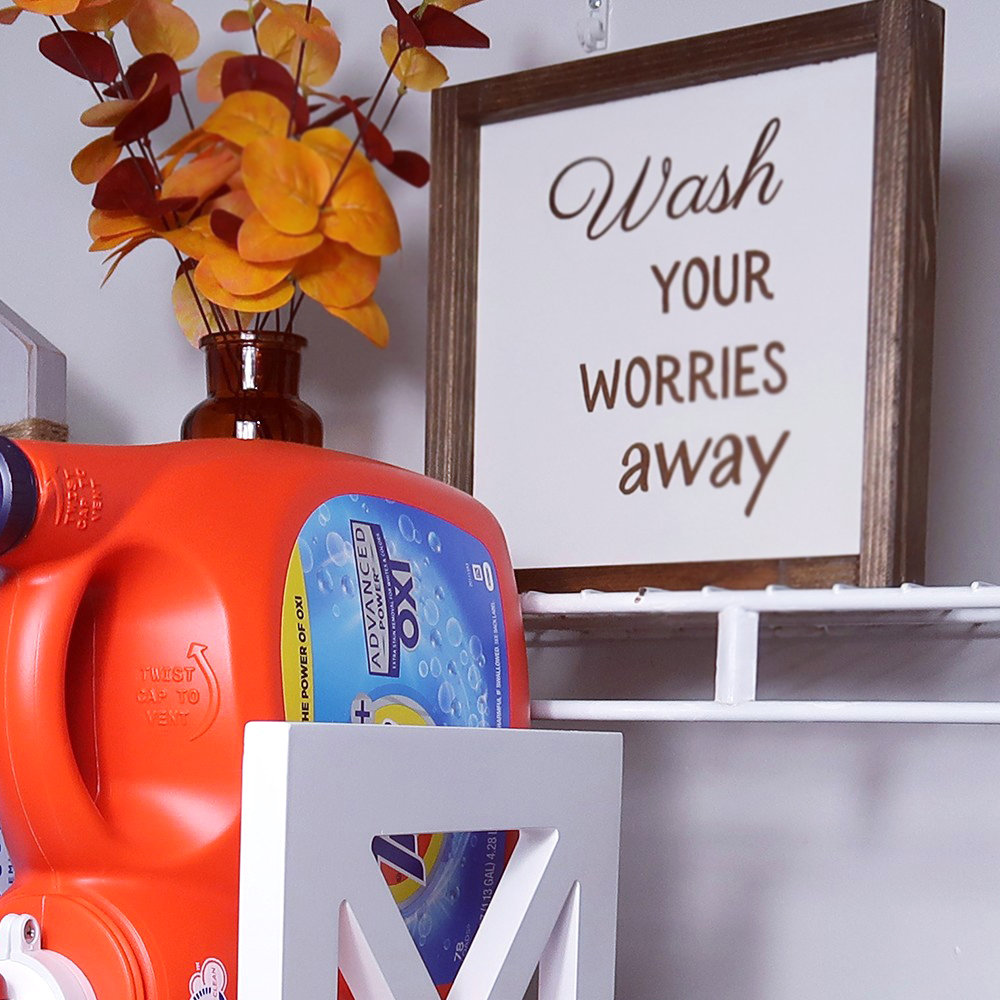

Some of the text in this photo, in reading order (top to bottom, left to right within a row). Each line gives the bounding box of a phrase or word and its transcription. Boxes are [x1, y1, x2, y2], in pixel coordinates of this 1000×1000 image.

[549, 117, 783, 240] Wash
[650, 250, 774, 314] YOUR
[579, 341, 788, 412] WORRIES
[618, 430, 791, 517] away
[295, 595, 304, 620] OXI
[355, 528, 381, 669] ADVANCED
[373, 572, 386, 630] POWER
[390, 559, 420, 648] OXI
[298, 622, 306, 642] OF
[136, 687, 200, 704] CAP TO
[140, 666, 195, 682] TWIST
[300, 645, 309, 699] POWER
[484, 862, 495, 886] GAL)
[486, 837, 497, 860] 4.28
